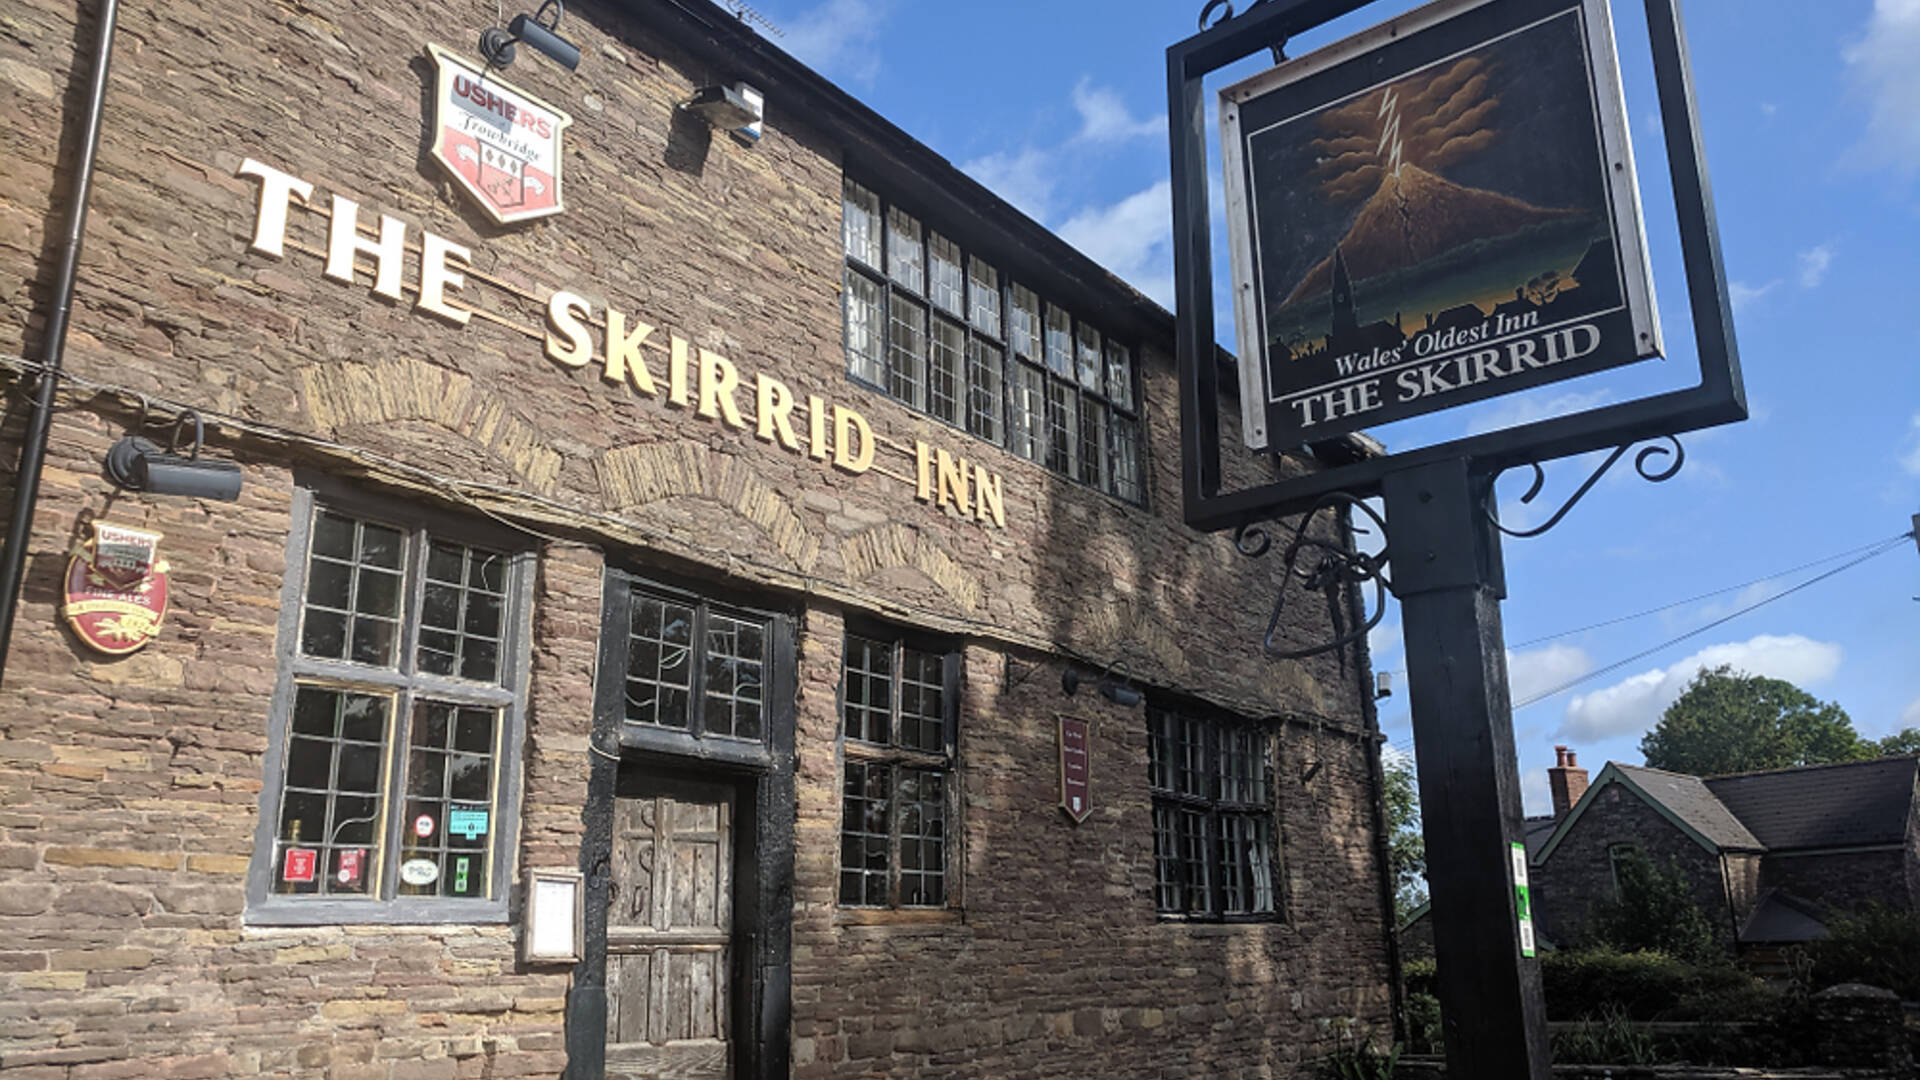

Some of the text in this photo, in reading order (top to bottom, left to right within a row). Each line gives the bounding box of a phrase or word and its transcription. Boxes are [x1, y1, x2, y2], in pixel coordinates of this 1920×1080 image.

[453, 74, 551, 140] USHERS
[458, 111, 541, 162] Trowbridge
[238, 157, 1004, 528] THE SKIRRID INN
[1334, 310, 1539, 377] Wales' Oldest Inn
[1291, 324, 1601, 428] THE SKIRRID
[101, 530, 154, 549] USHERS
[85, 586, 151, 606] FINE ALES
